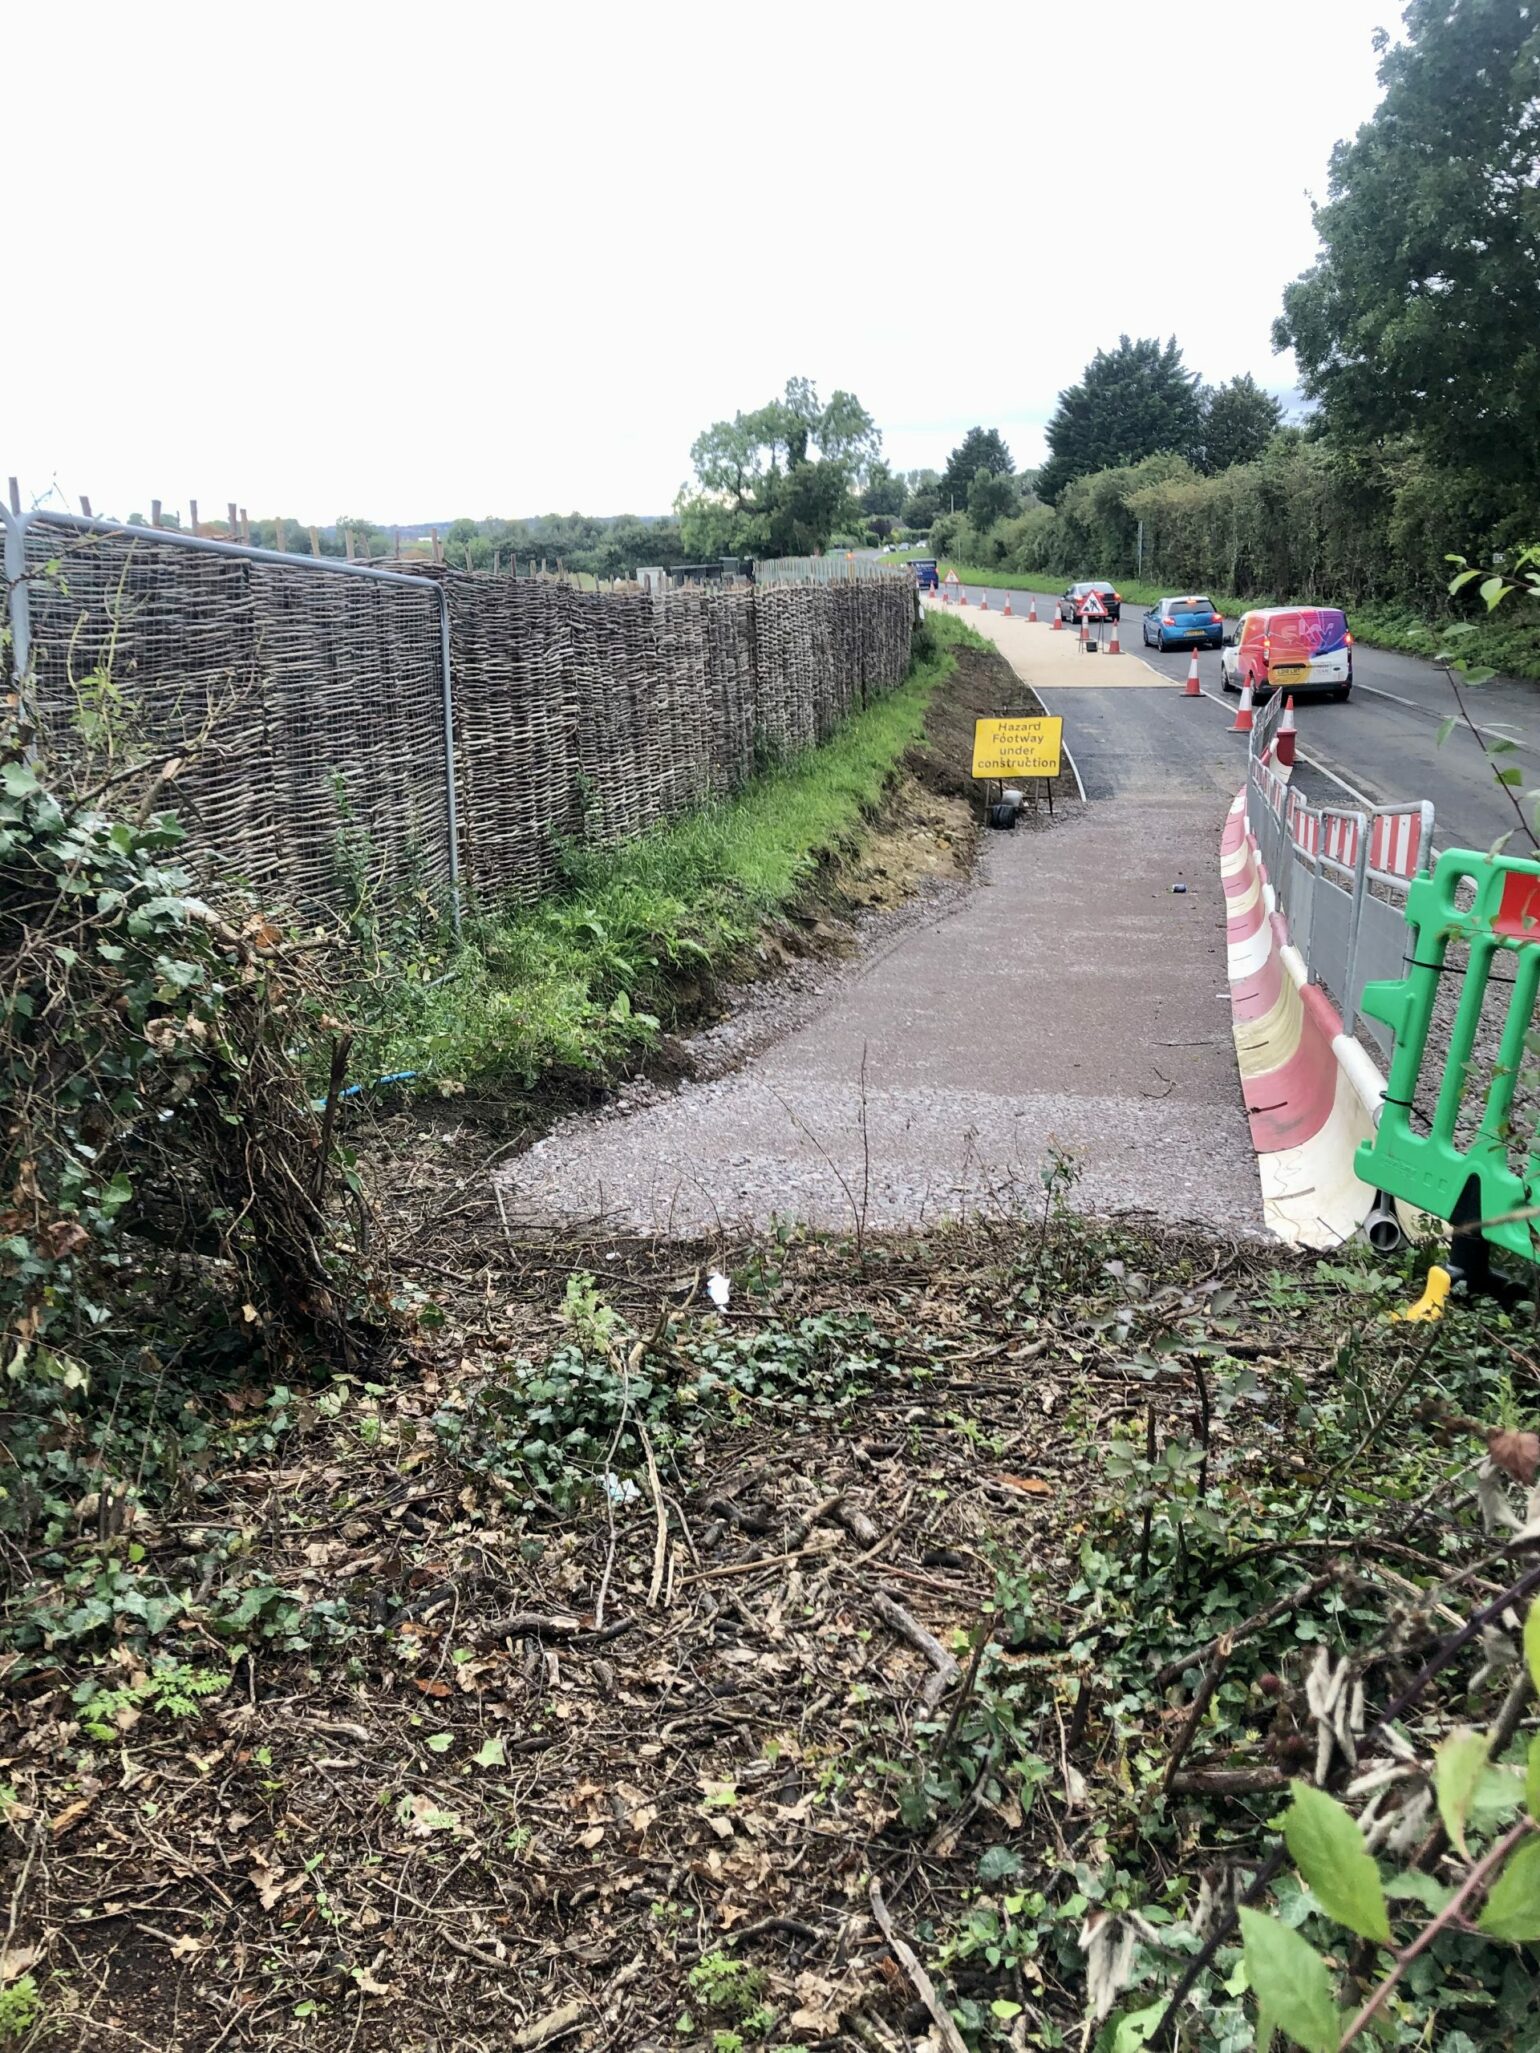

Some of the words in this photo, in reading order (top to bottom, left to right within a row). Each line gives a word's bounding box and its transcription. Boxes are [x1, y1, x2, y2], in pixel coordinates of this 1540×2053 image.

[998, 721, 1041, 731] Hazard
[992, 734, 1044, 744] Footway
[999, 747, 1035, 755] under
[977, 758, 1056, 768] construction
